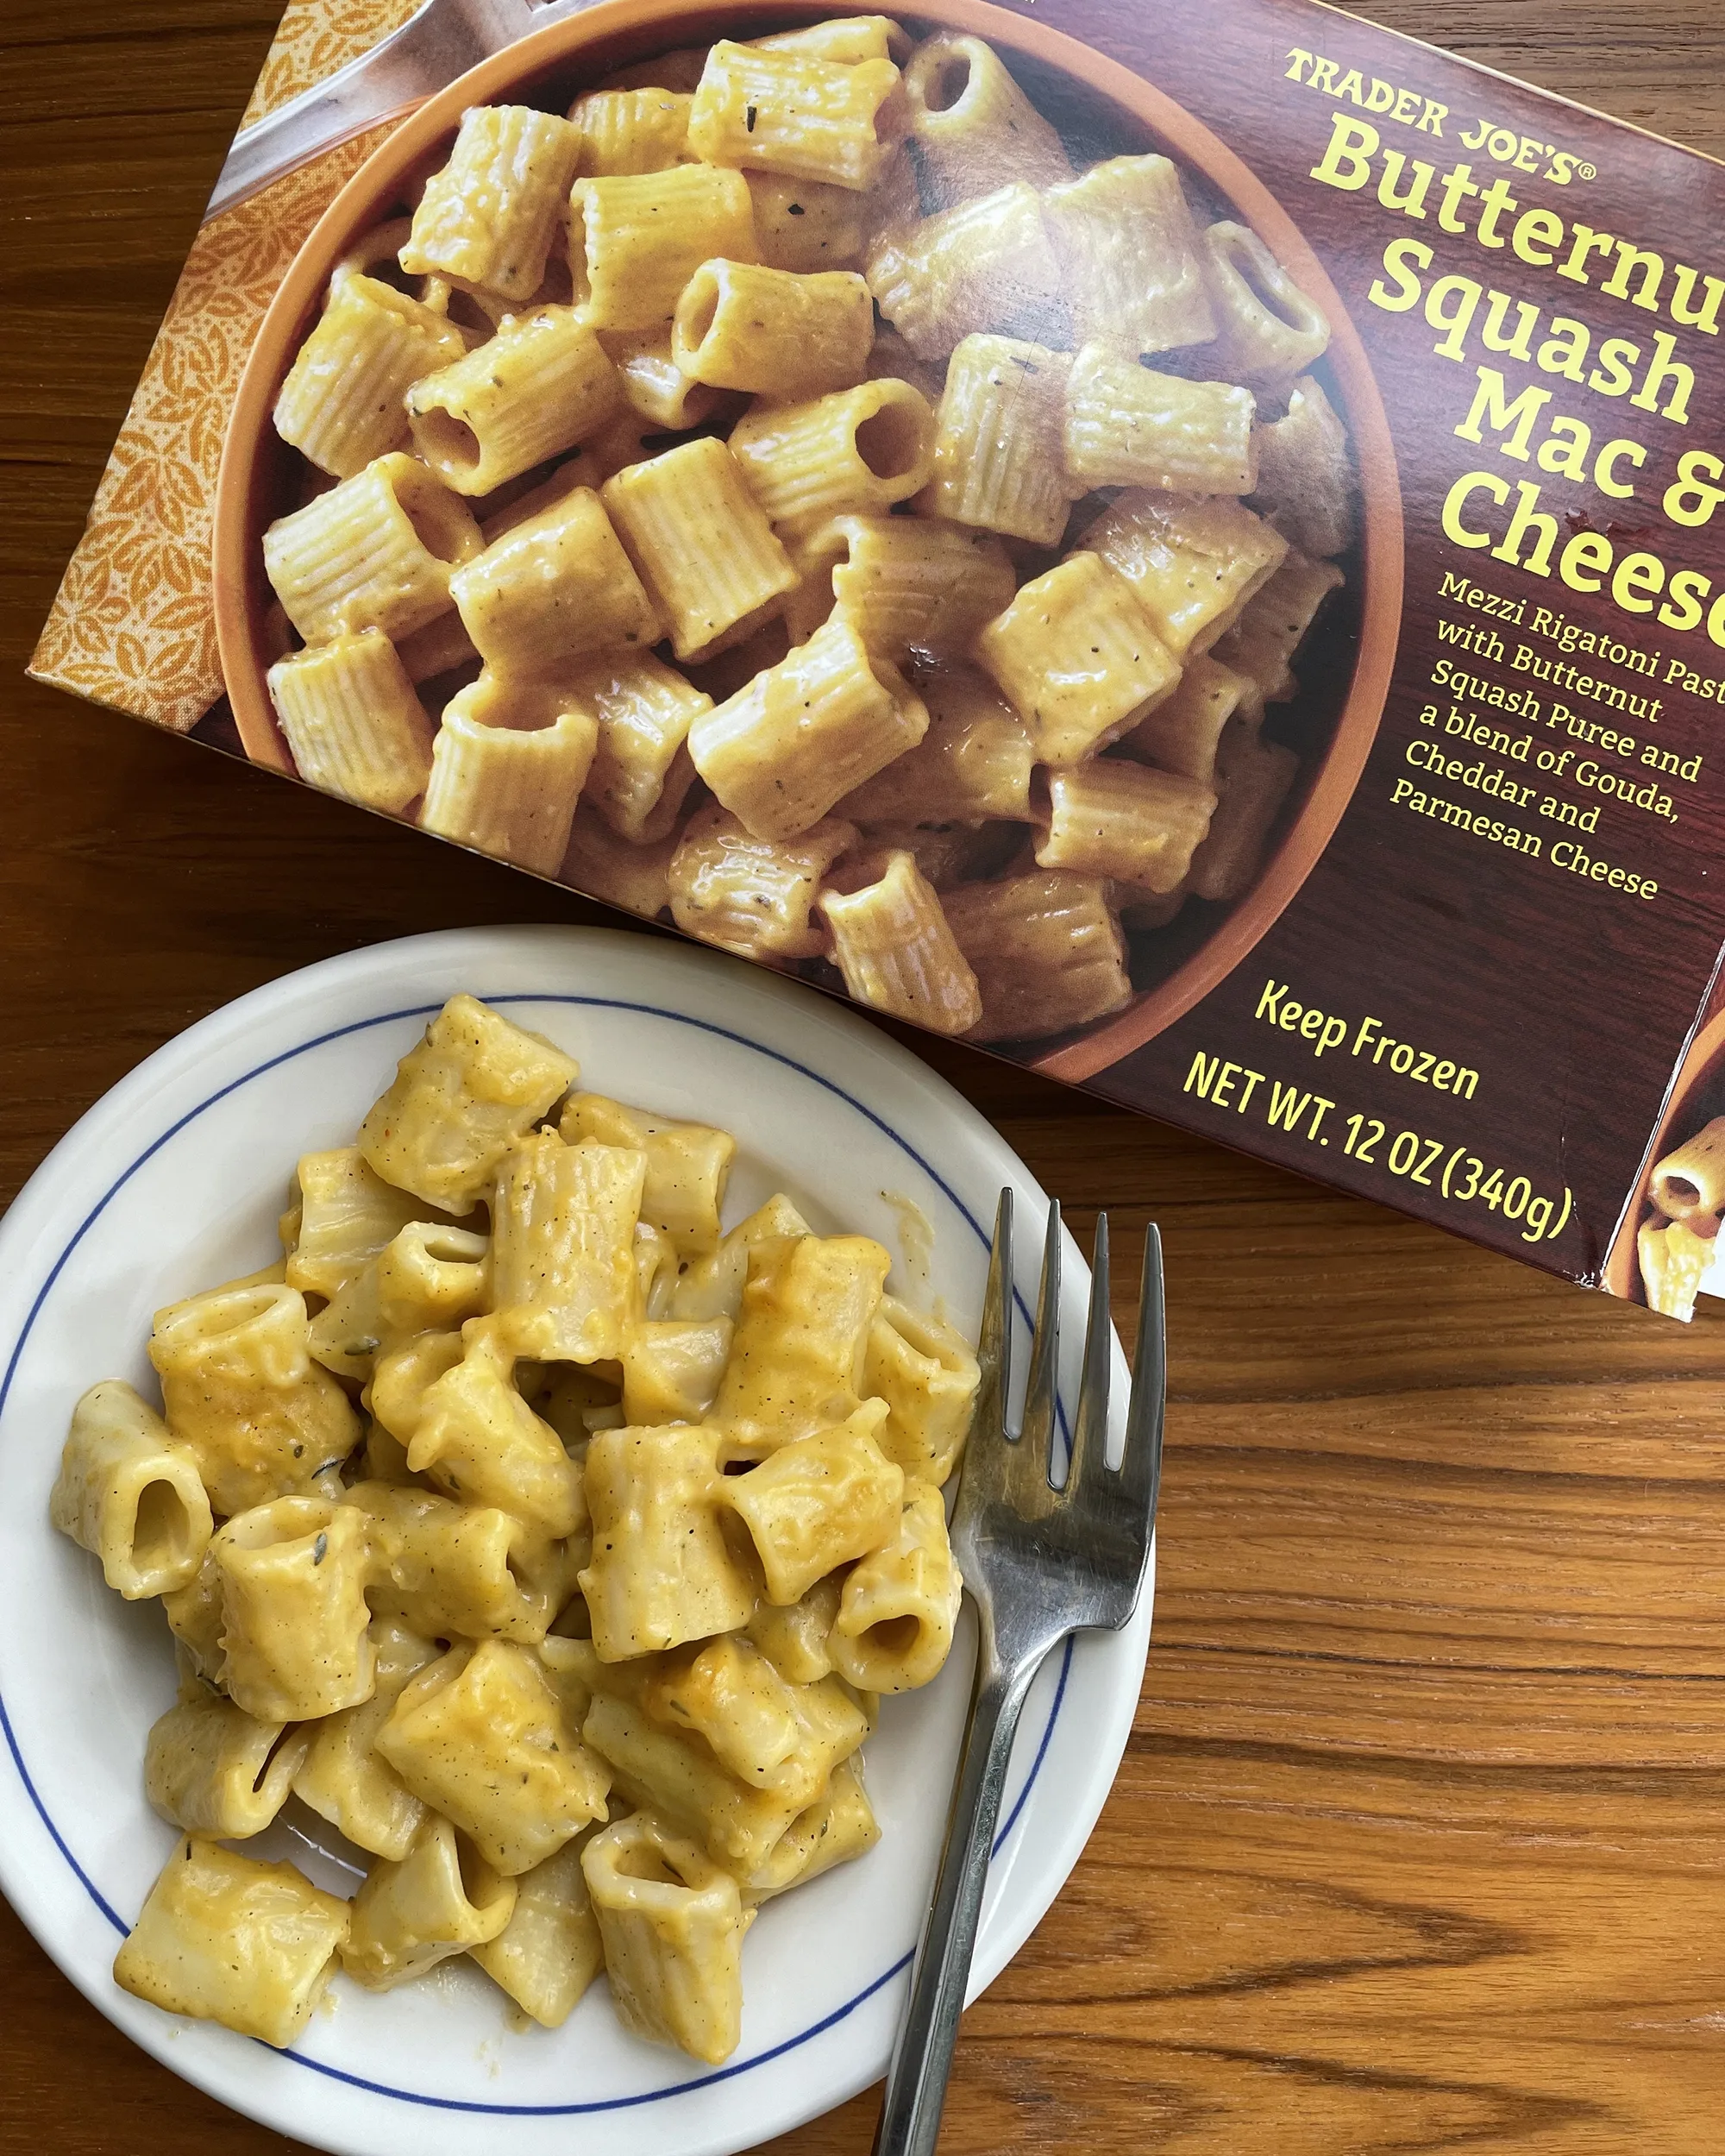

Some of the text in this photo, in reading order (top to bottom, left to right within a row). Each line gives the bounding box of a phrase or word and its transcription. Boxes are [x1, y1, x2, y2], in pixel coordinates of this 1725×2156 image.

[1284, 47, 1449, 137] TRADER
[1309, 111, 1725, 336] Butternu
[1368, 237, 1695, 425] Squash
[1453, 365, 1725, 527] Mac &
[1437, 571, 1528, 625] Mezzi
[1528, 606, 1662, 677] Rigatoni
[1437, 619, 1664, 723] with Butternut
[1419, 705, 1679, 825] a blend of Gouda,
[1430, 658, 1704, 783] Squash Puree and
[1389, 778, 1659, 901] Parmesan Cheese
[1405, 739, 1603, 834] Cheddar and
[1254, 978, 1480, 1101] Keep Frozen
[1182, 1050, 1266, 1115] NET
[1266, 1079, 1337, 1147] WT.
[1342, 1112, 1386, 1165] 12
